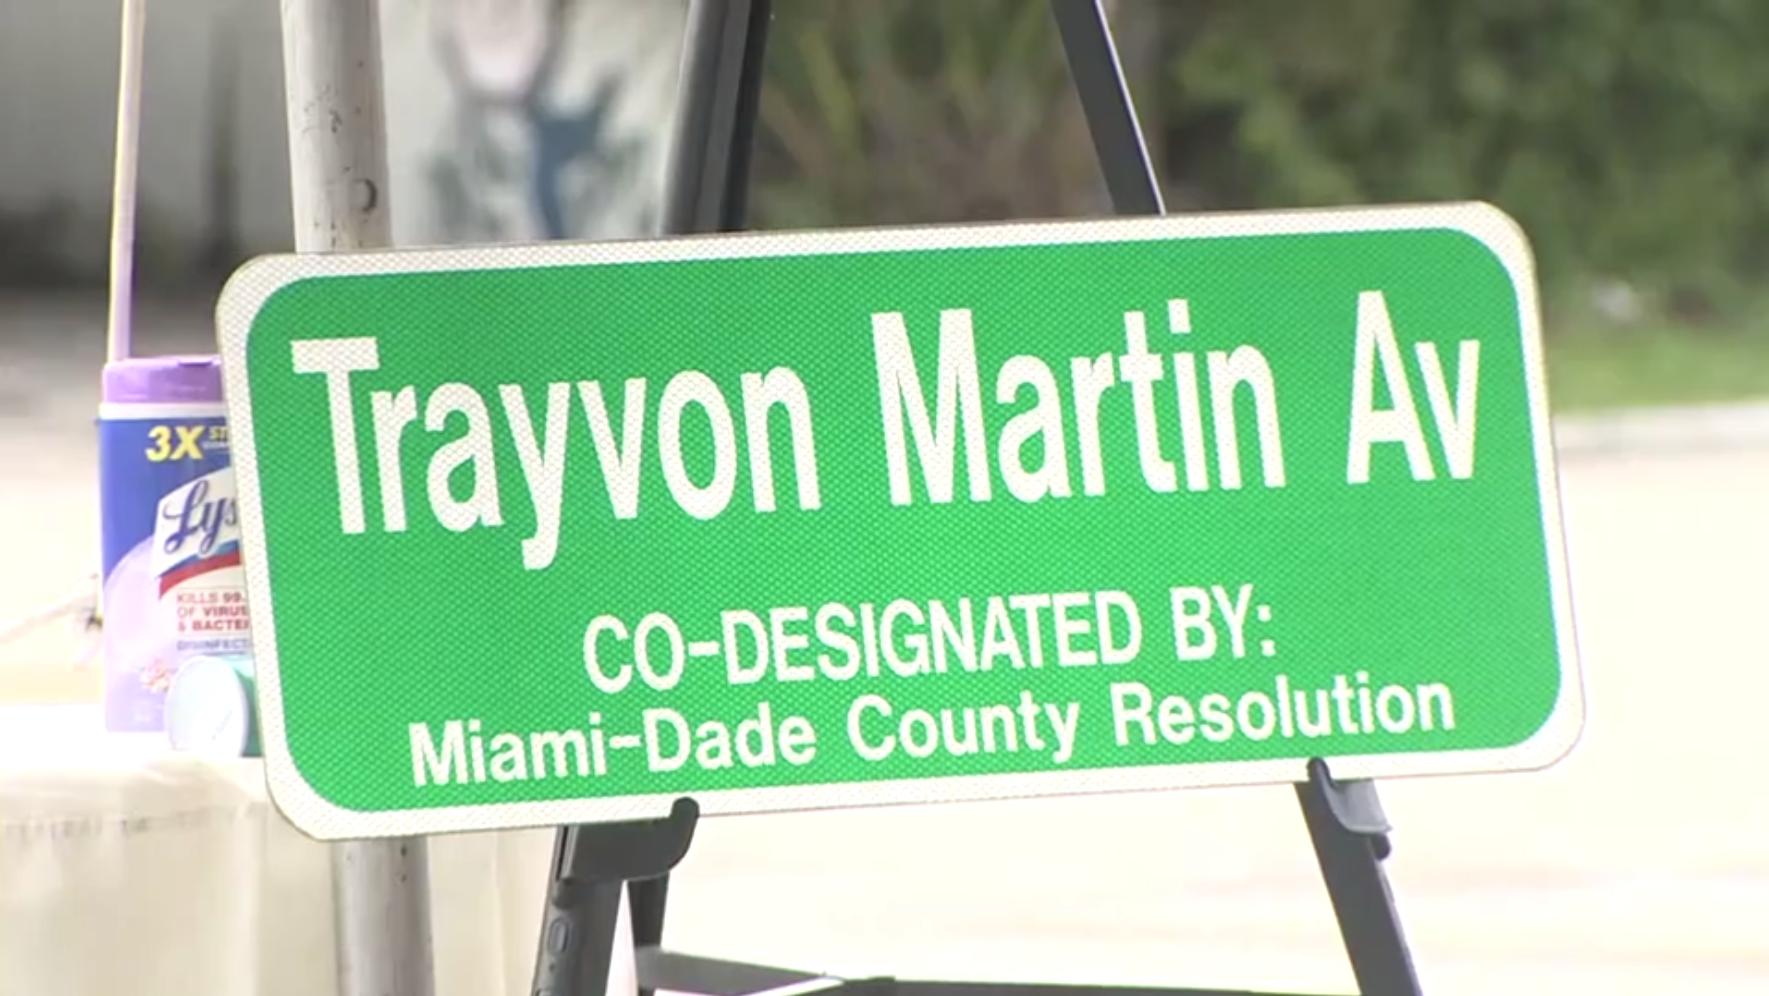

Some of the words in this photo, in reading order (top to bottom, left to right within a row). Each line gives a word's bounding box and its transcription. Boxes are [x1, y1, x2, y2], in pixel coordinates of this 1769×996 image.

[145, 425, 204, 462] 3X
[291, 336, 821, 569] Trayvon
[871, 299, 1286, 506] Martin
[1347, 290, 1480, 489] Av
[177, 606, 195, 617] OF
[583, 586, 1142, 693] CO-DESIGNATED
[1170, 584, 1275, 660] BY:
[409, 702, 816, 786] Miami-Dade
[848, 694, 1080, 763] County
[1110, 673, 1455, 750] Resolution
